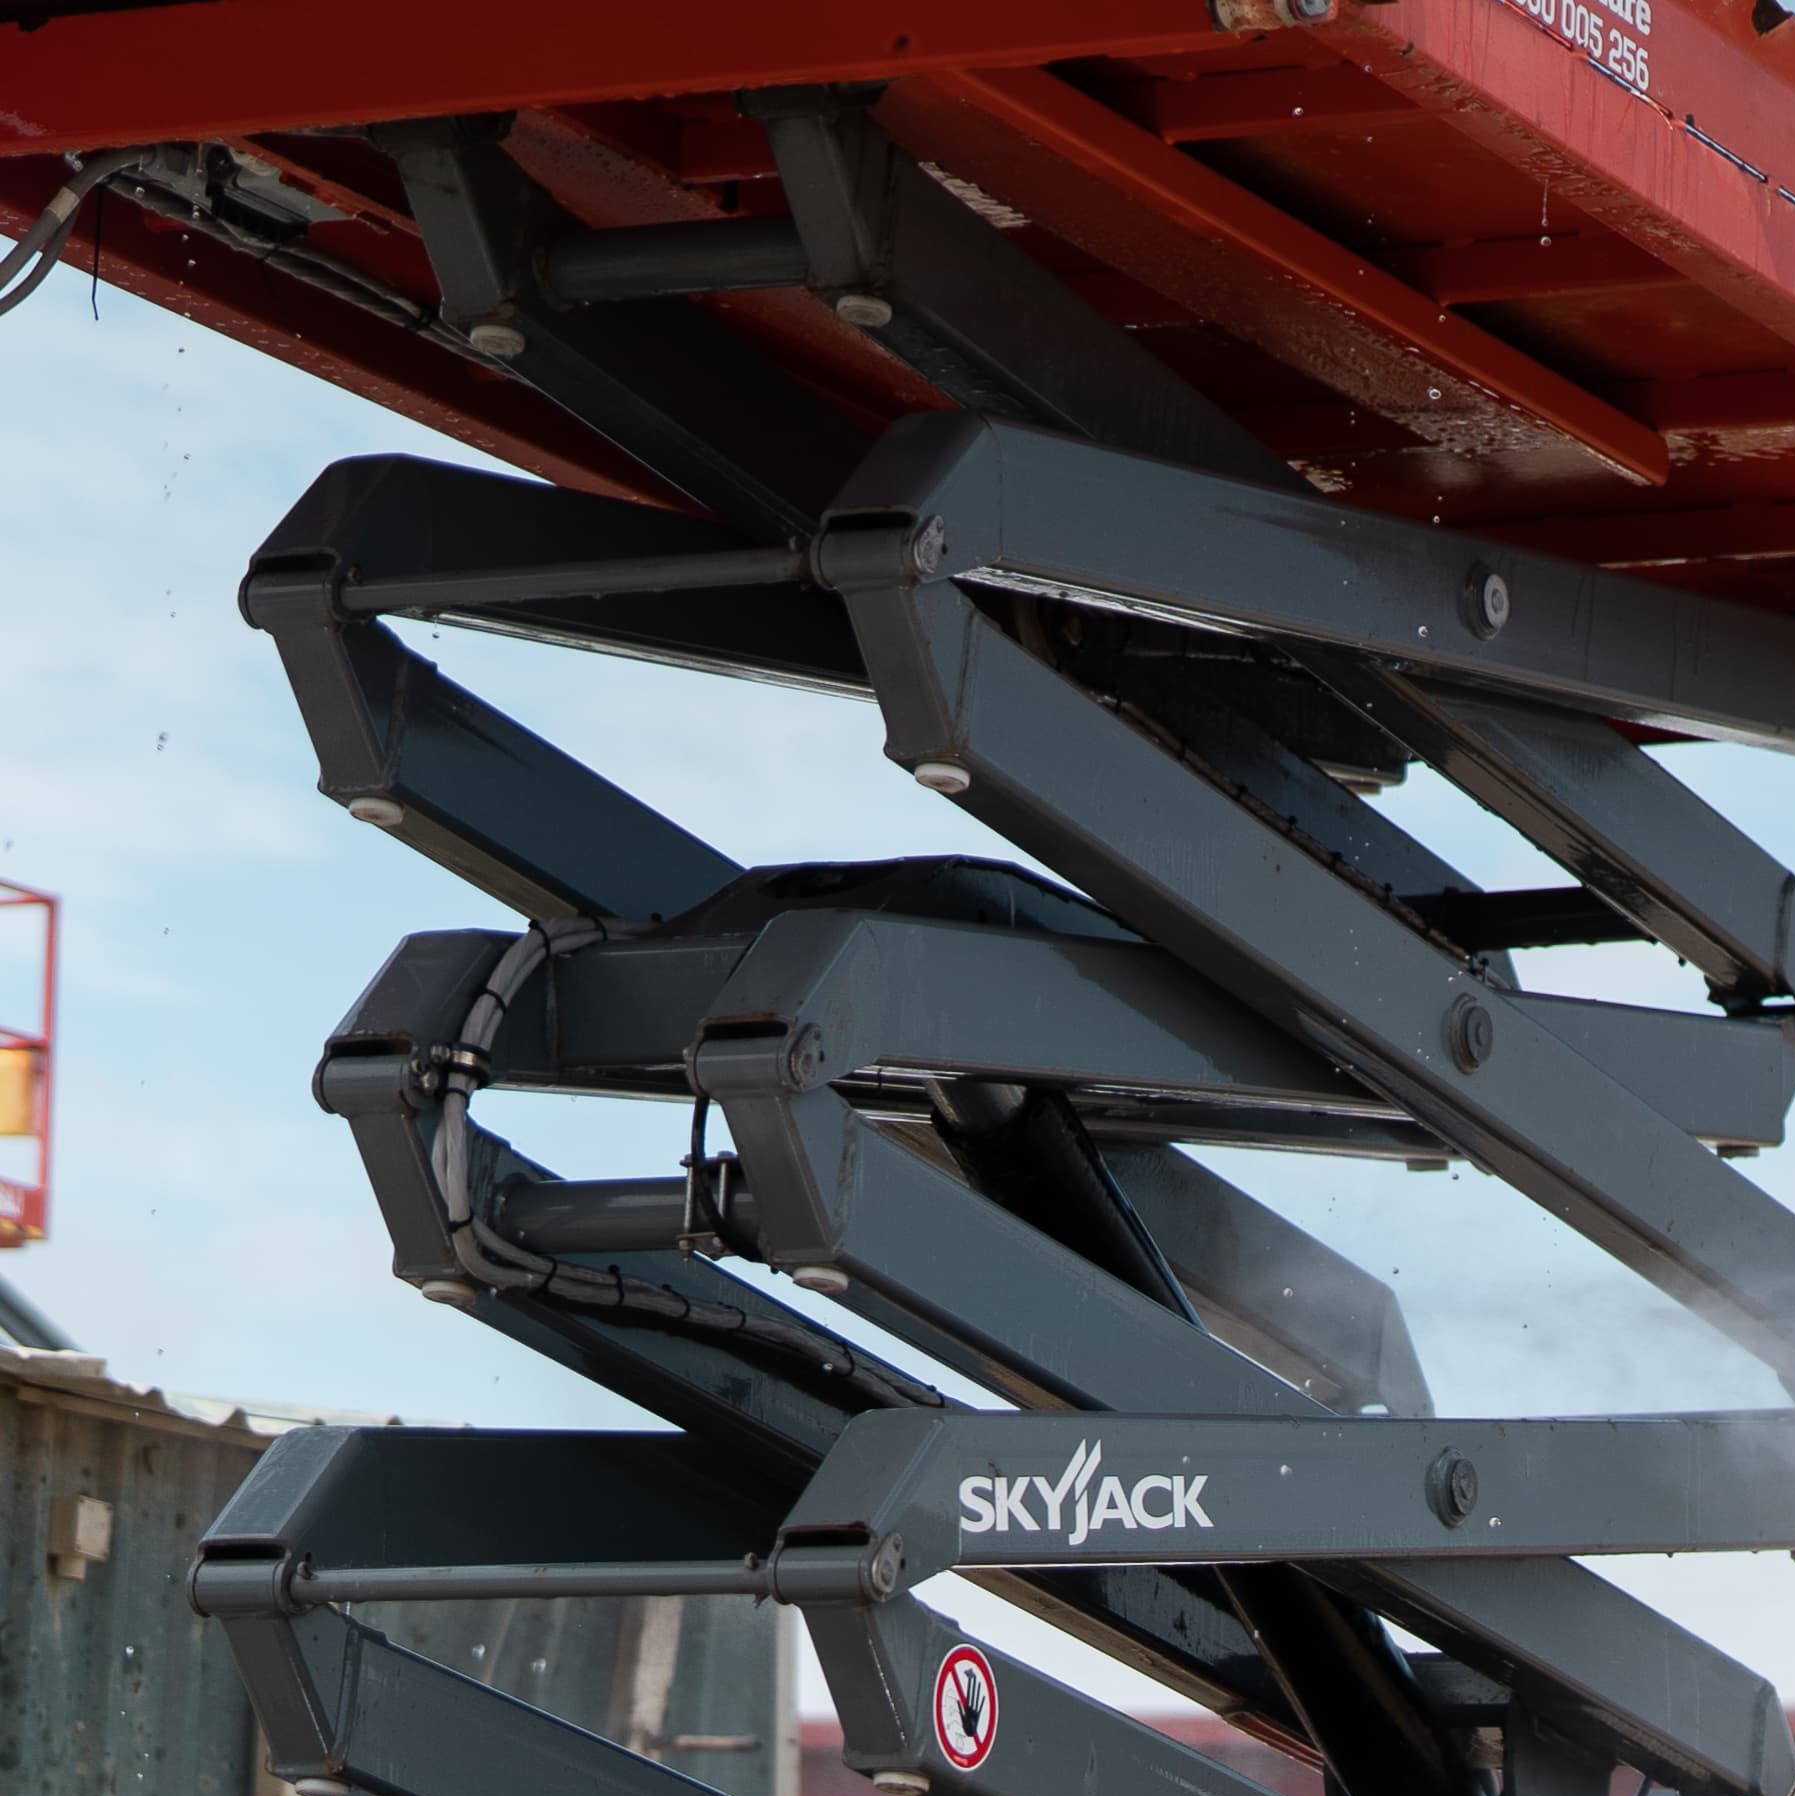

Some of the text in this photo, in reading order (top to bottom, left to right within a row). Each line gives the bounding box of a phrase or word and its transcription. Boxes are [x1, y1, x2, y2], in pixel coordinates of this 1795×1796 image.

[1560, 0, 1604, 58] 005
[1608, 28, 1650, 91] 256
[958, 1437, 1216, 1547] SKYJACK
